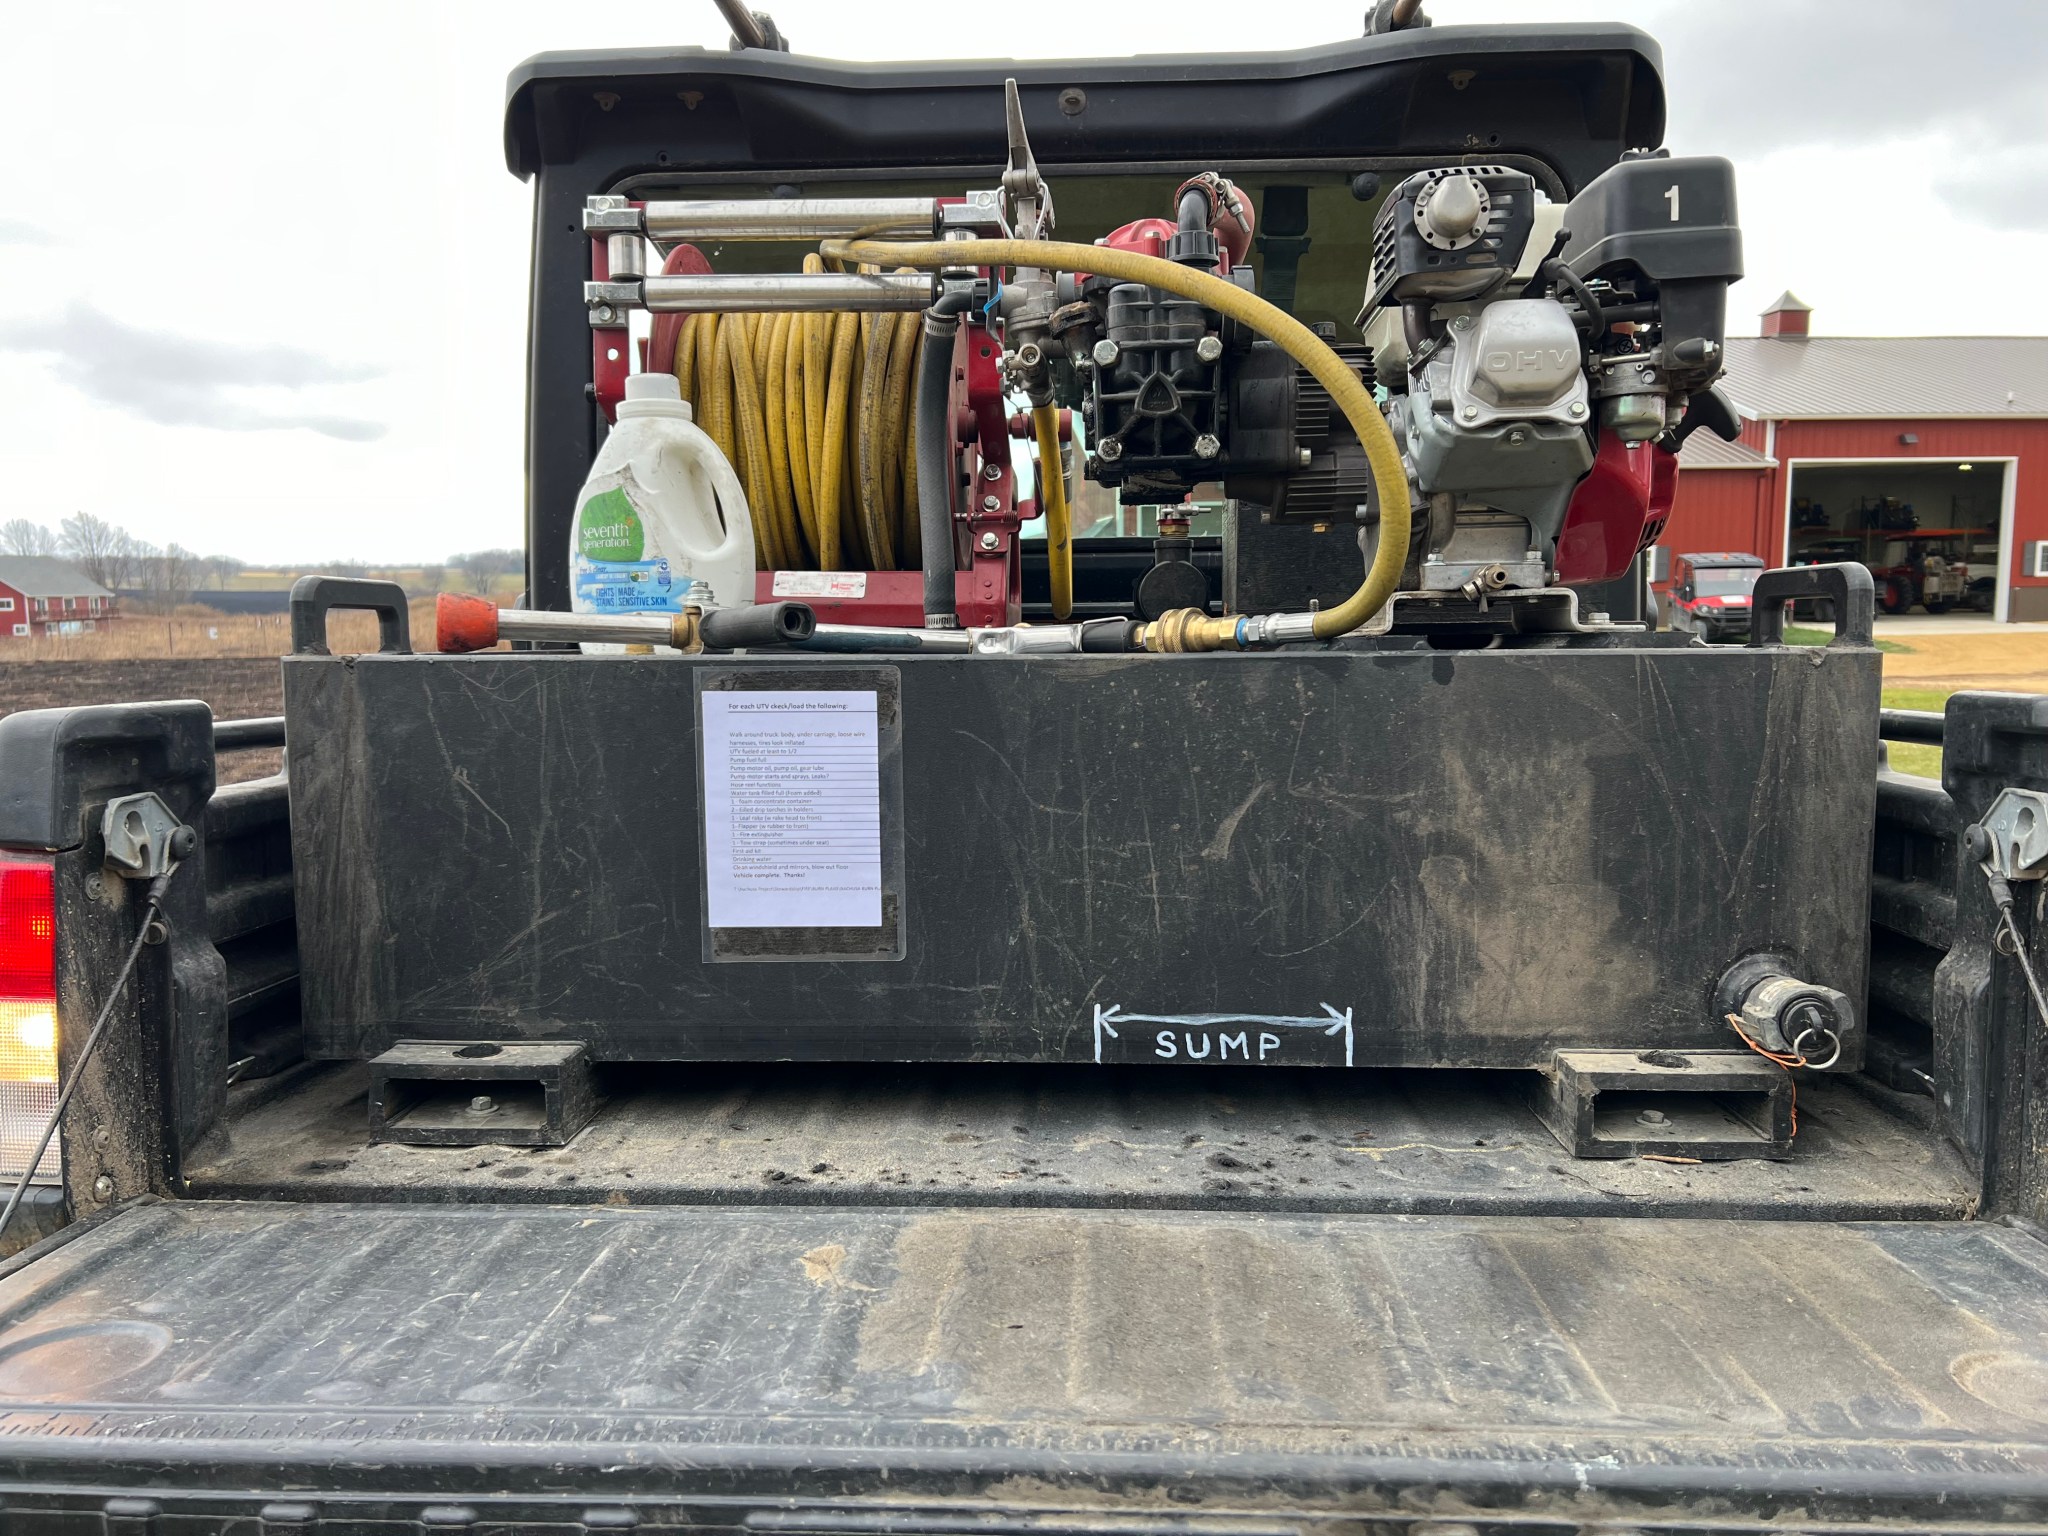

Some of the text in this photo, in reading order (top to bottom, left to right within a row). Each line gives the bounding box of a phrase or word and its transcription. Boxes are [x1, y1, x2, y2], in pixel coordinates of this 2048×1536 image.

[1664, 185, 1679, 221] 1
[1486, 349, 1573, 372] OHV
[583, 523, 629, 539] seventh
[596, 588, 615, 597] FIGHTS
[618, 587, 635, 596] MADE
[596, 597, 615, 606] STAINS
[618, 597, 668, 606] SENSITIVE SKIN
[1155, 1031, 1280, 1060] SUMP
